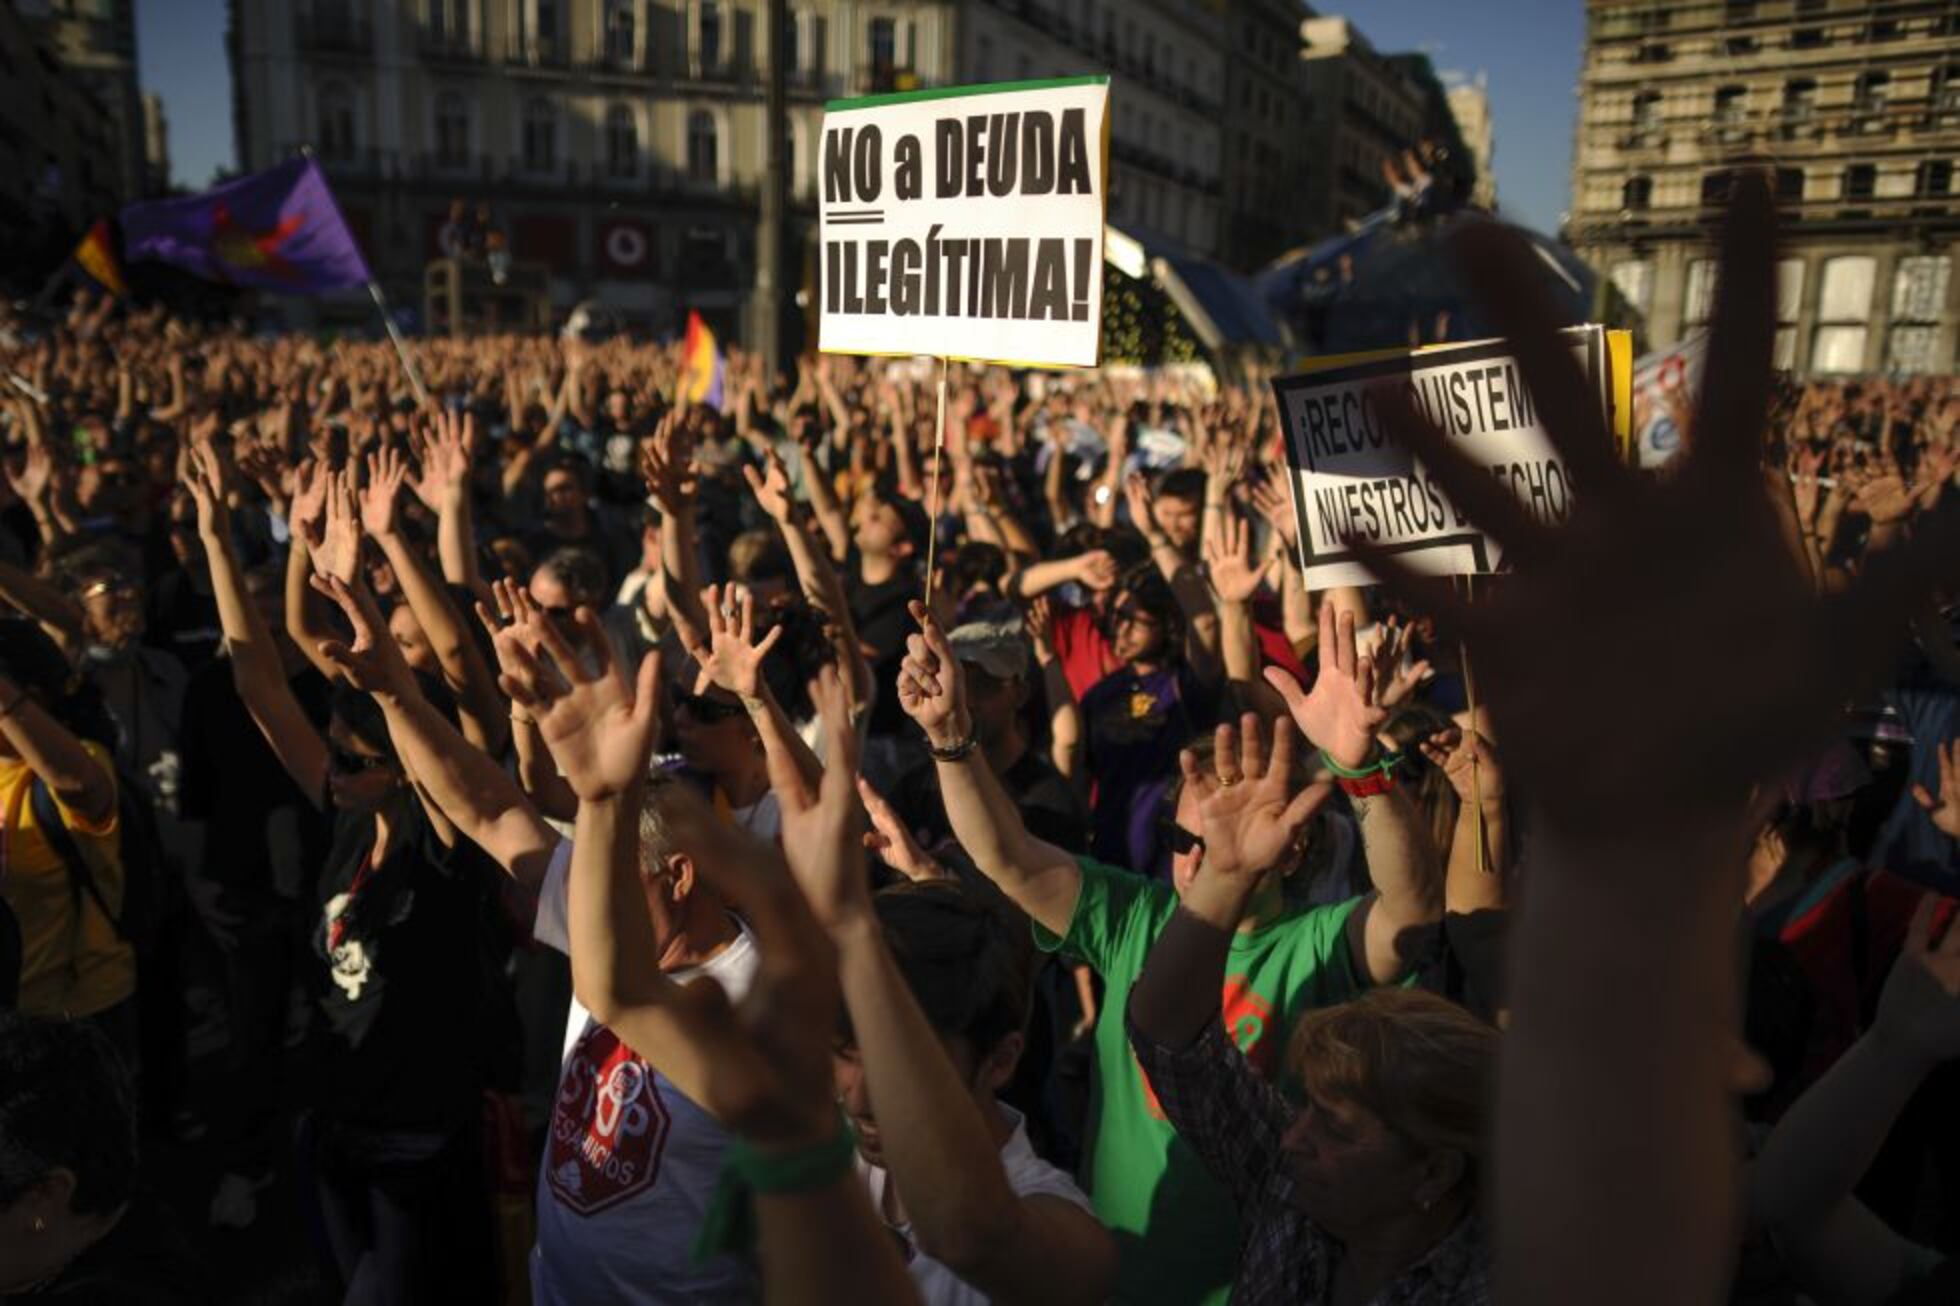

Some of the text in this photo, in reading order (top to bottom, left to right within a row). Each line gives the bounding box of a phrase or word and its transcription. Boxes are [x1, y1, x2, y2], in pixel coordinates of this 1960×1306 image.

[825, 108, 1093, 203] NO a DEUDA
[826, 224, 1093, 322] ILEGÍTIMA!
[1314, 472, 1445, 547] NUESTROS
